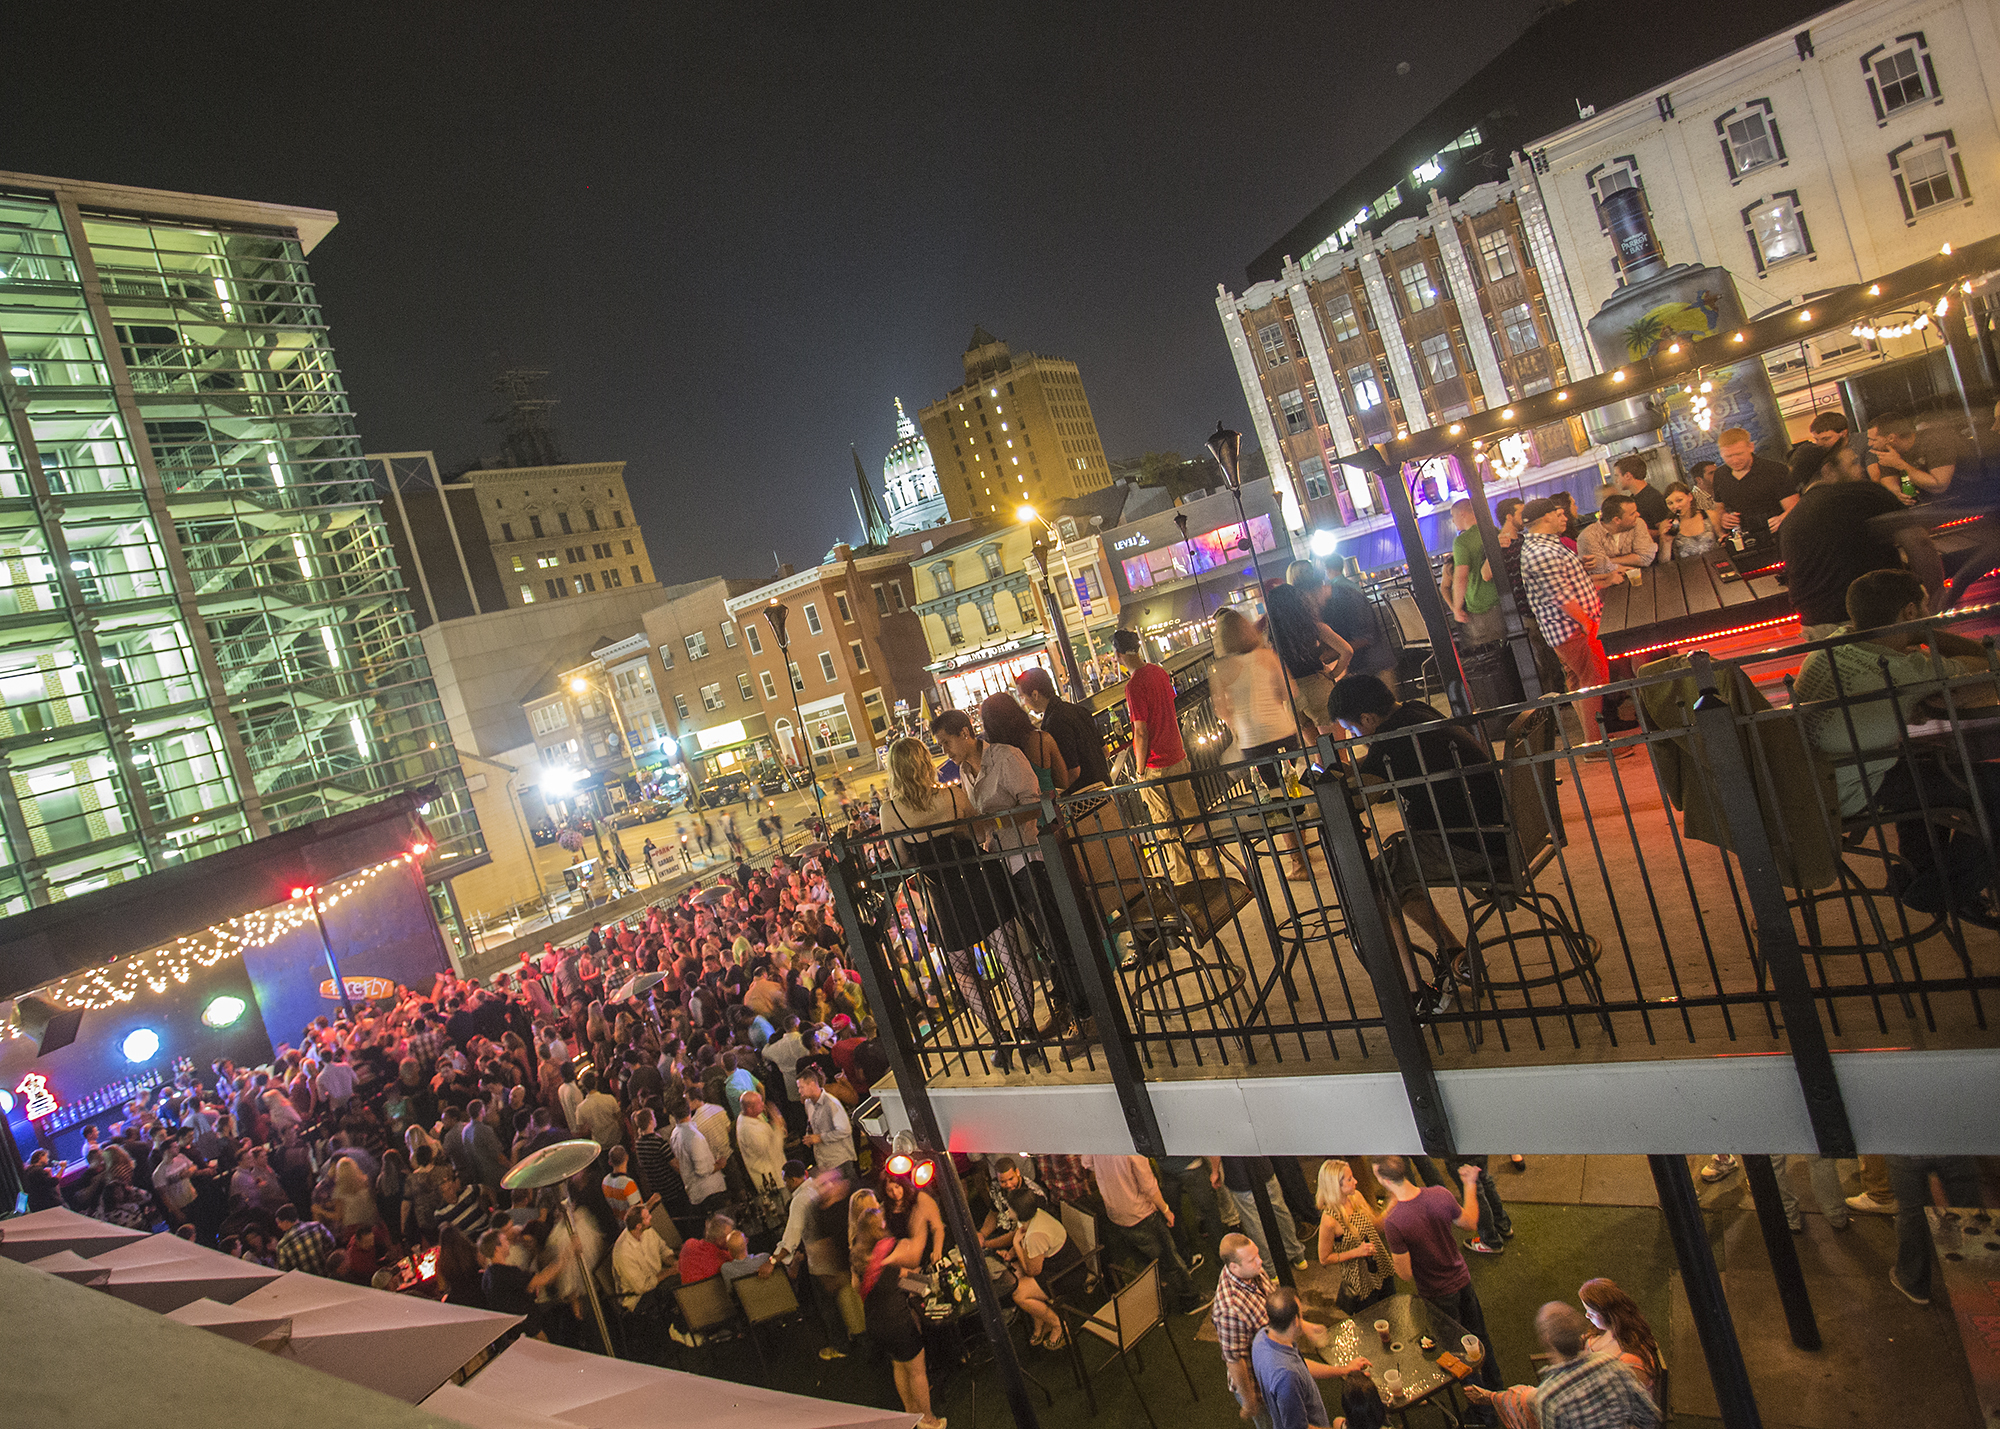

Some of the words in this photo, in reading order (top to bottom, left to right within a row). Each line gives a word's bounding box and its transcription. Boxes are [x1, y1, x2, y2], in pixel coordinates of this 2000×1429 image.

[1621, 234, 1647, 251] PARROT
[1630, 244, 1644, 254] BAY
[655, 846, 670, 856] PARK
[657, 855, 675, 867] GARAGE
[658, 864, 680, 878] ENTRANCE
